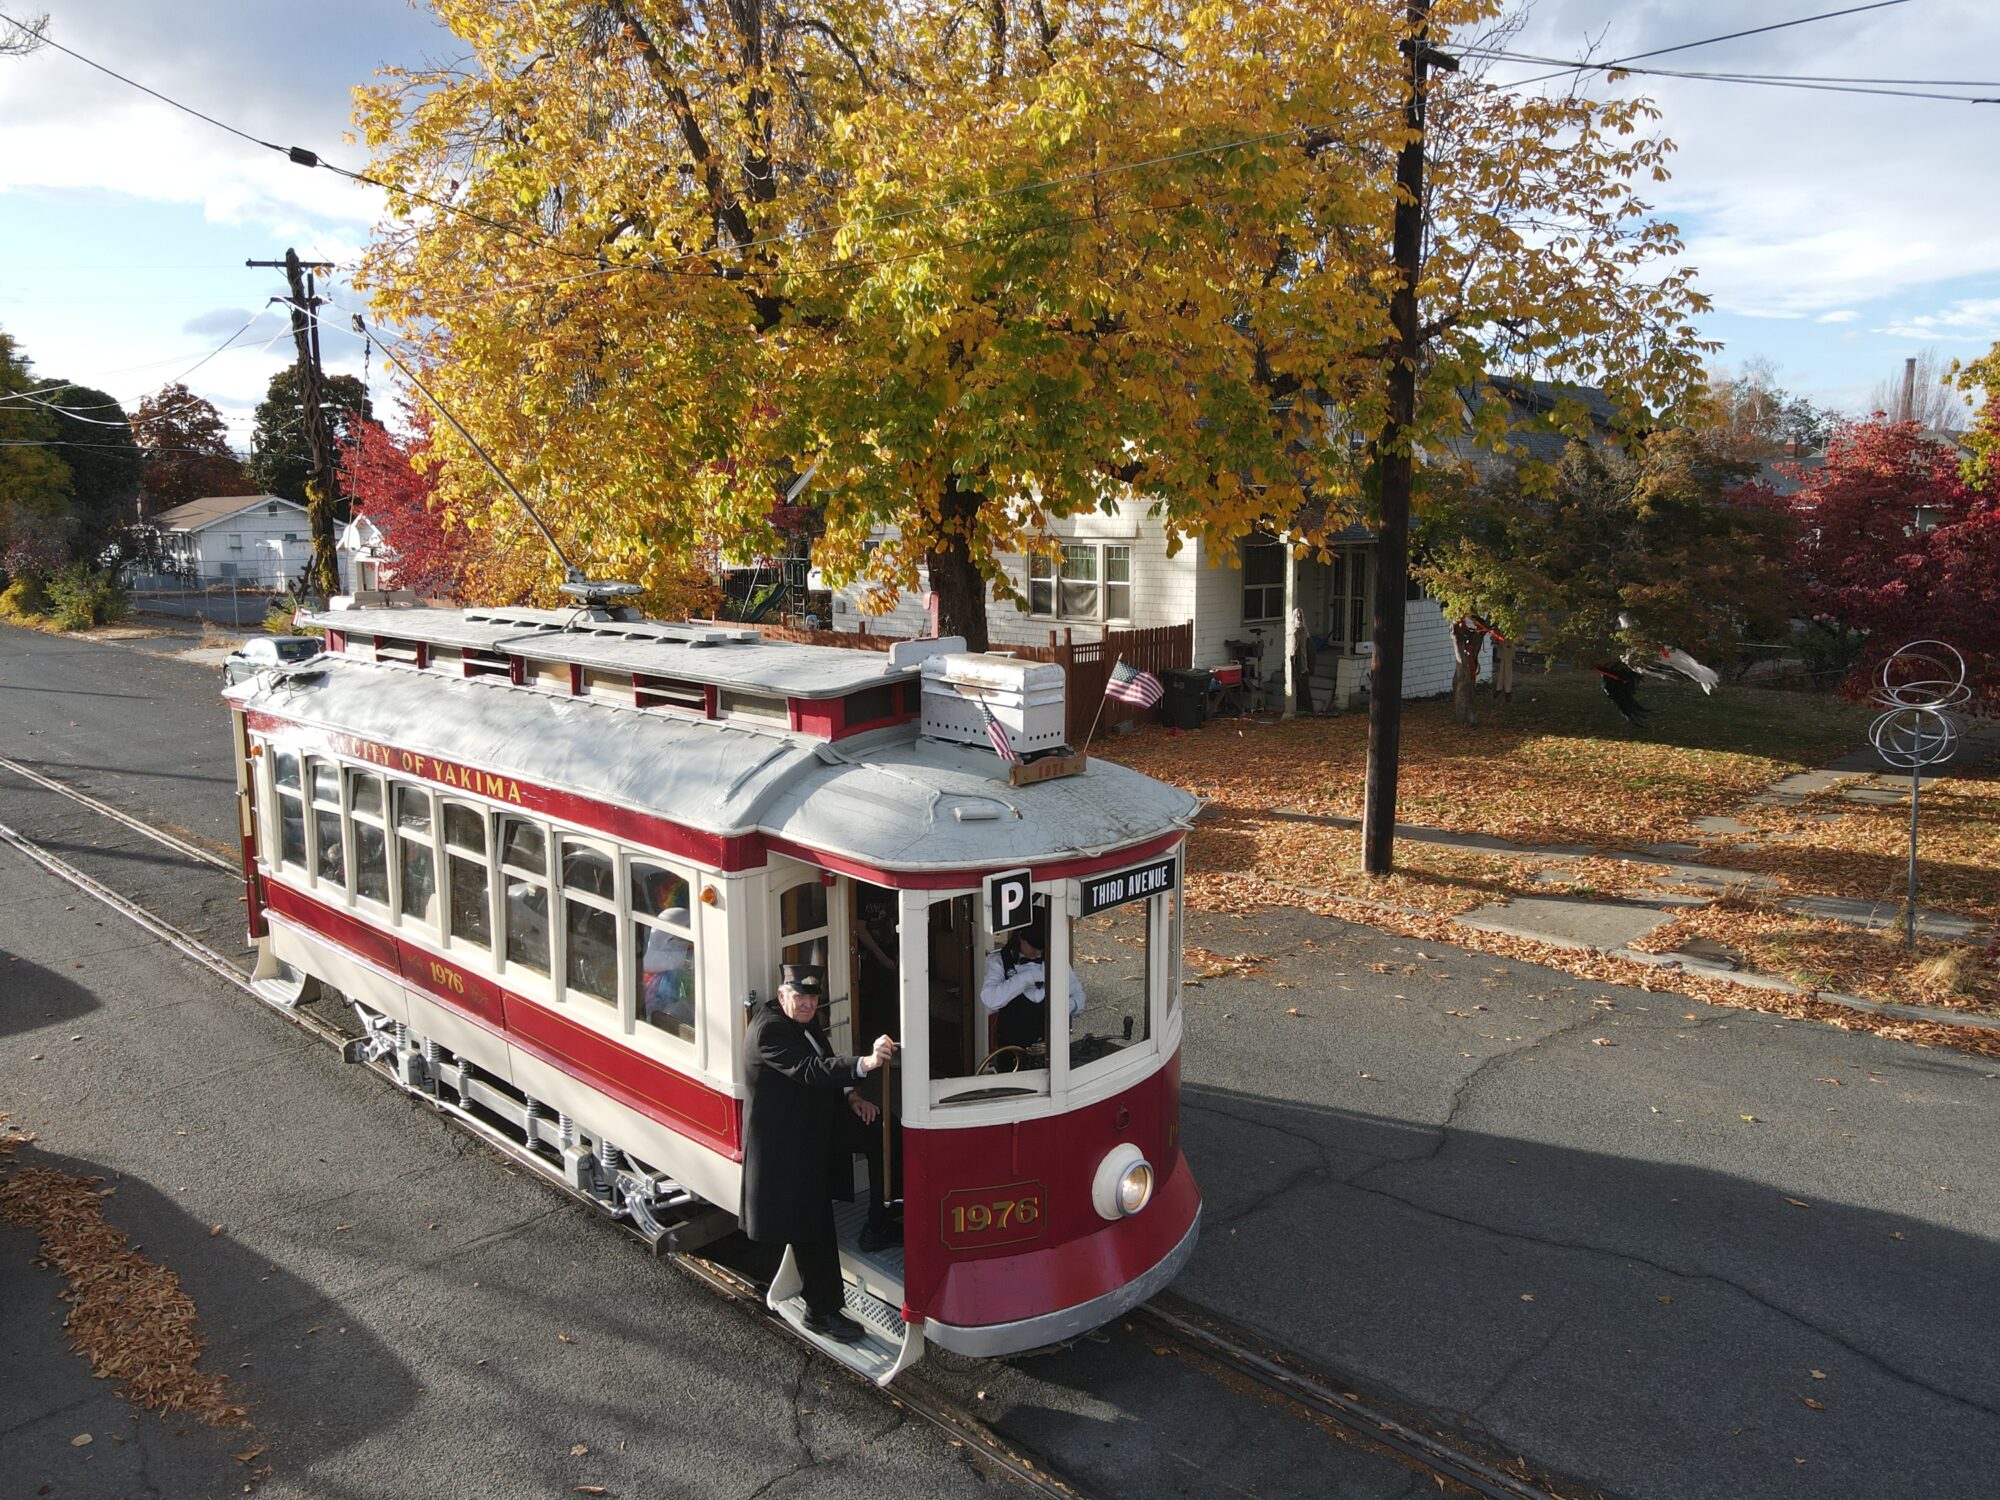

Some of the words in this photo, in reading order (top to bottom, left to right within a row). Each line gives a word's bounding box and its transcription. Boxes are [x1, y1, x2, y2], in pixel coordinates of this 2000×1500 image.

[352, 738, 391, 766] CITY
[402, 753, 425, 774] OF
[433, 760, 521, 803] YAKIMA
[1001, 881, 1024, 926] P
[1092, 878, 1123, 908] THIRD
[1128, 865, 1168, 897] AVENUE
[430, 961, 465, 994] 1976
[951, 1196, 1038, 1233] 1976
